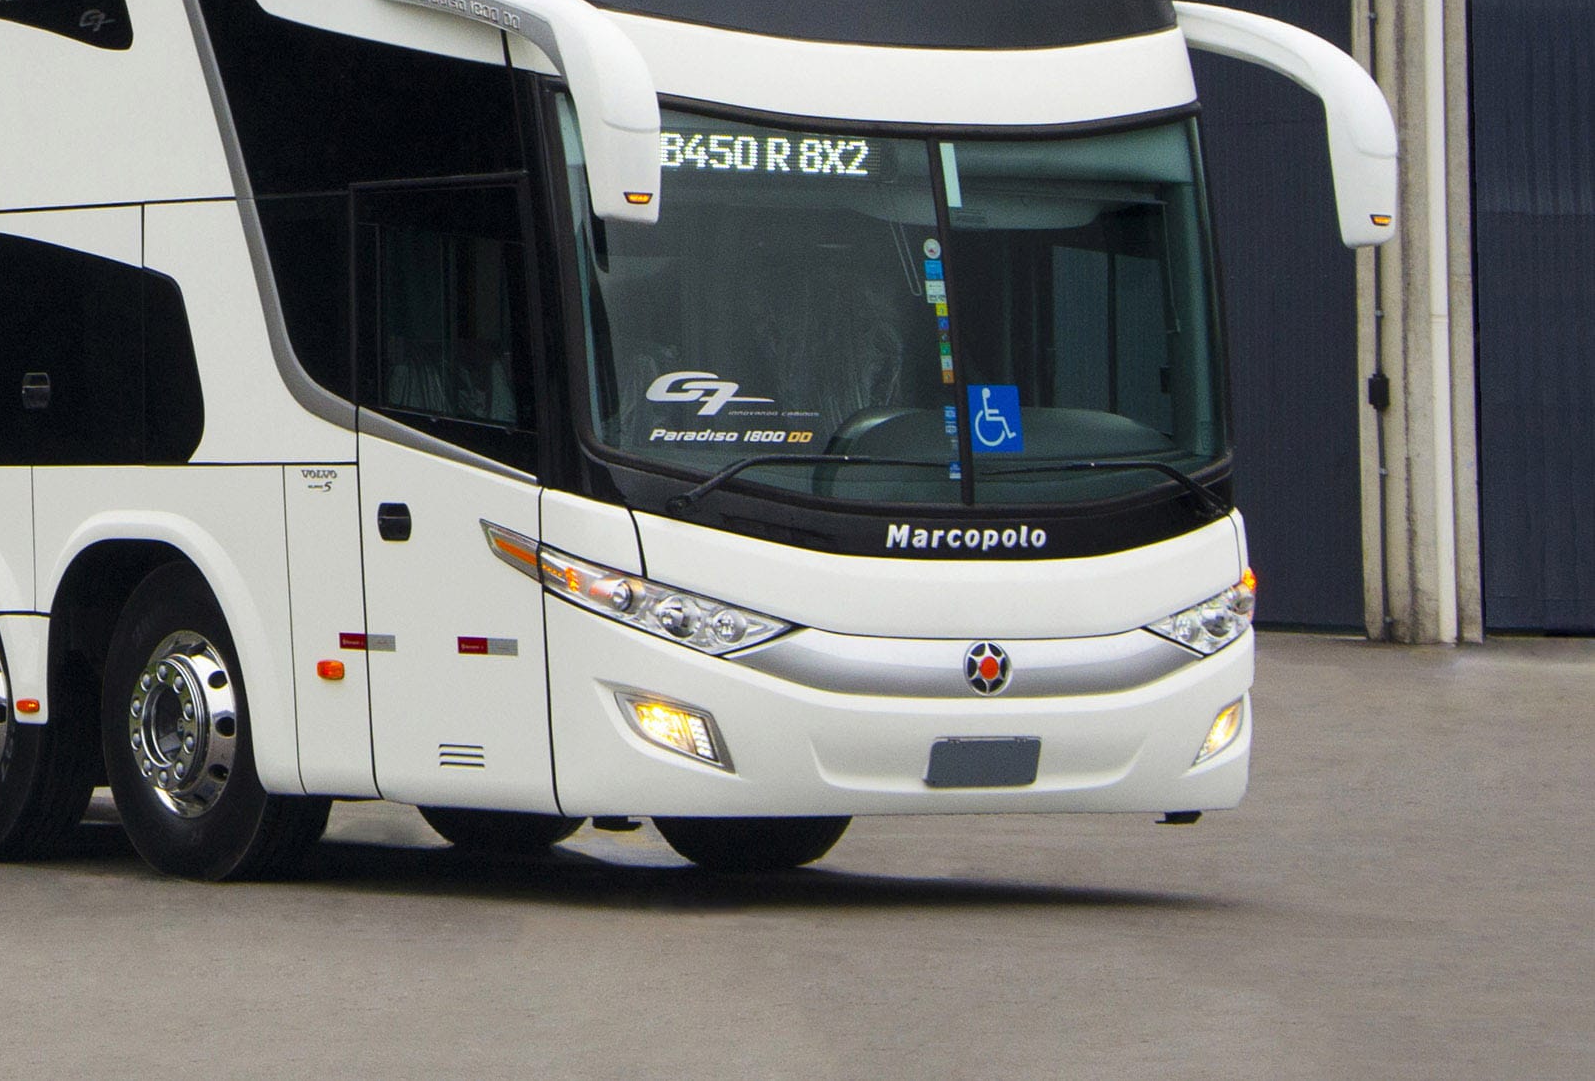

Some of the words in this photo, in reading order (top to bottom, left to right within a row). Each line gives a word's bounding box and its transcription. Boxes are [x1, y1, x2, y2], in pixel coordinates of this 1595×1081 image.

[660, 132, 759, 170] B450
[766, 136, 792, 172] R
[799, 138, 870, 175] 8X2
[649, 428, 739, 443] Paradiso
[743, 430, 787, 444] 1800
[786, 430, 814, 444] DD
[300, 468, 338, 479] VOLVO
[885, 523, 1048, 553] Marcopolo
